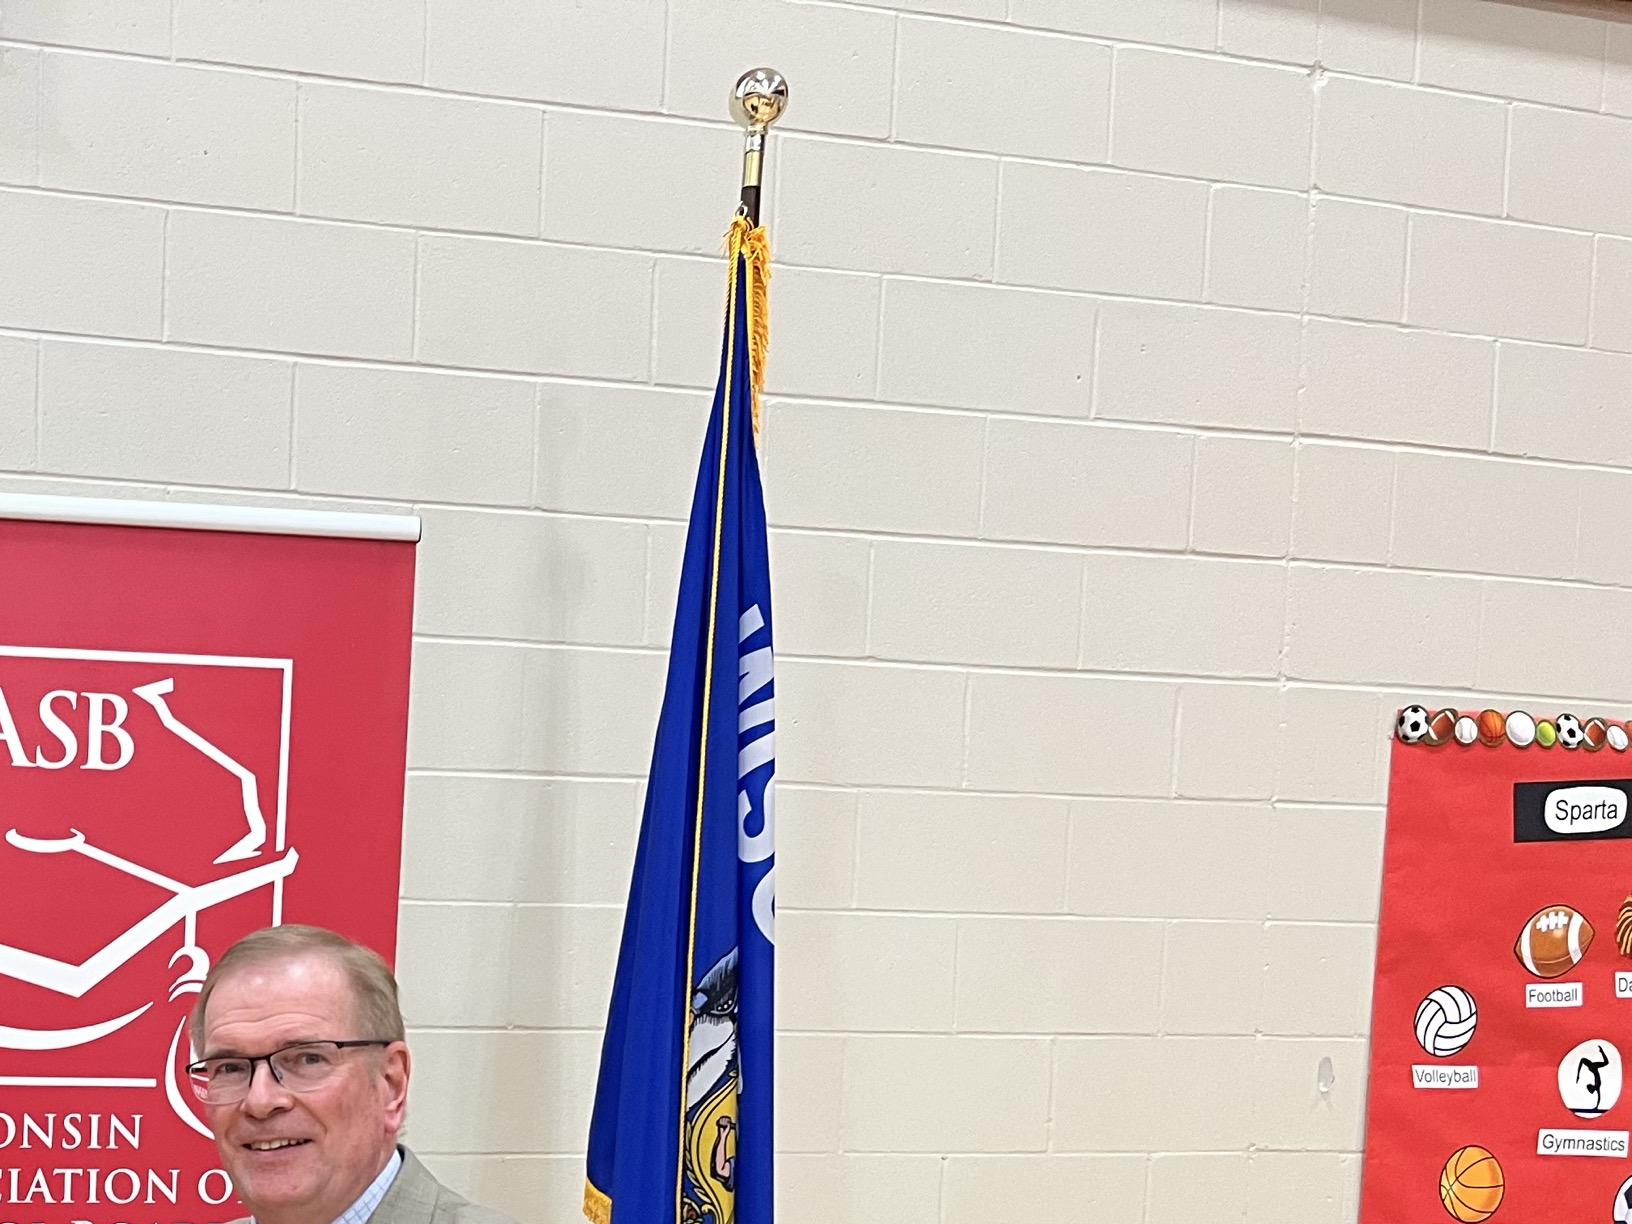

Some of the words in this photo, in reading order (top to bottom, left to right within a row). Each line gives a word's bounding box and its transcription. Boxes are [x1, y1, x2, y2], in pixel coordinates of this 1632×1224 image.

[1555, 799, 1618, 826] Sparta
[1528, 988, 1578, 1003] Football
[1415, 1069, 1477, 1086] Volleyball
[1542, 1134, 1625, 1152] Gymnastics
[198, 1169, 243, 1205] O
